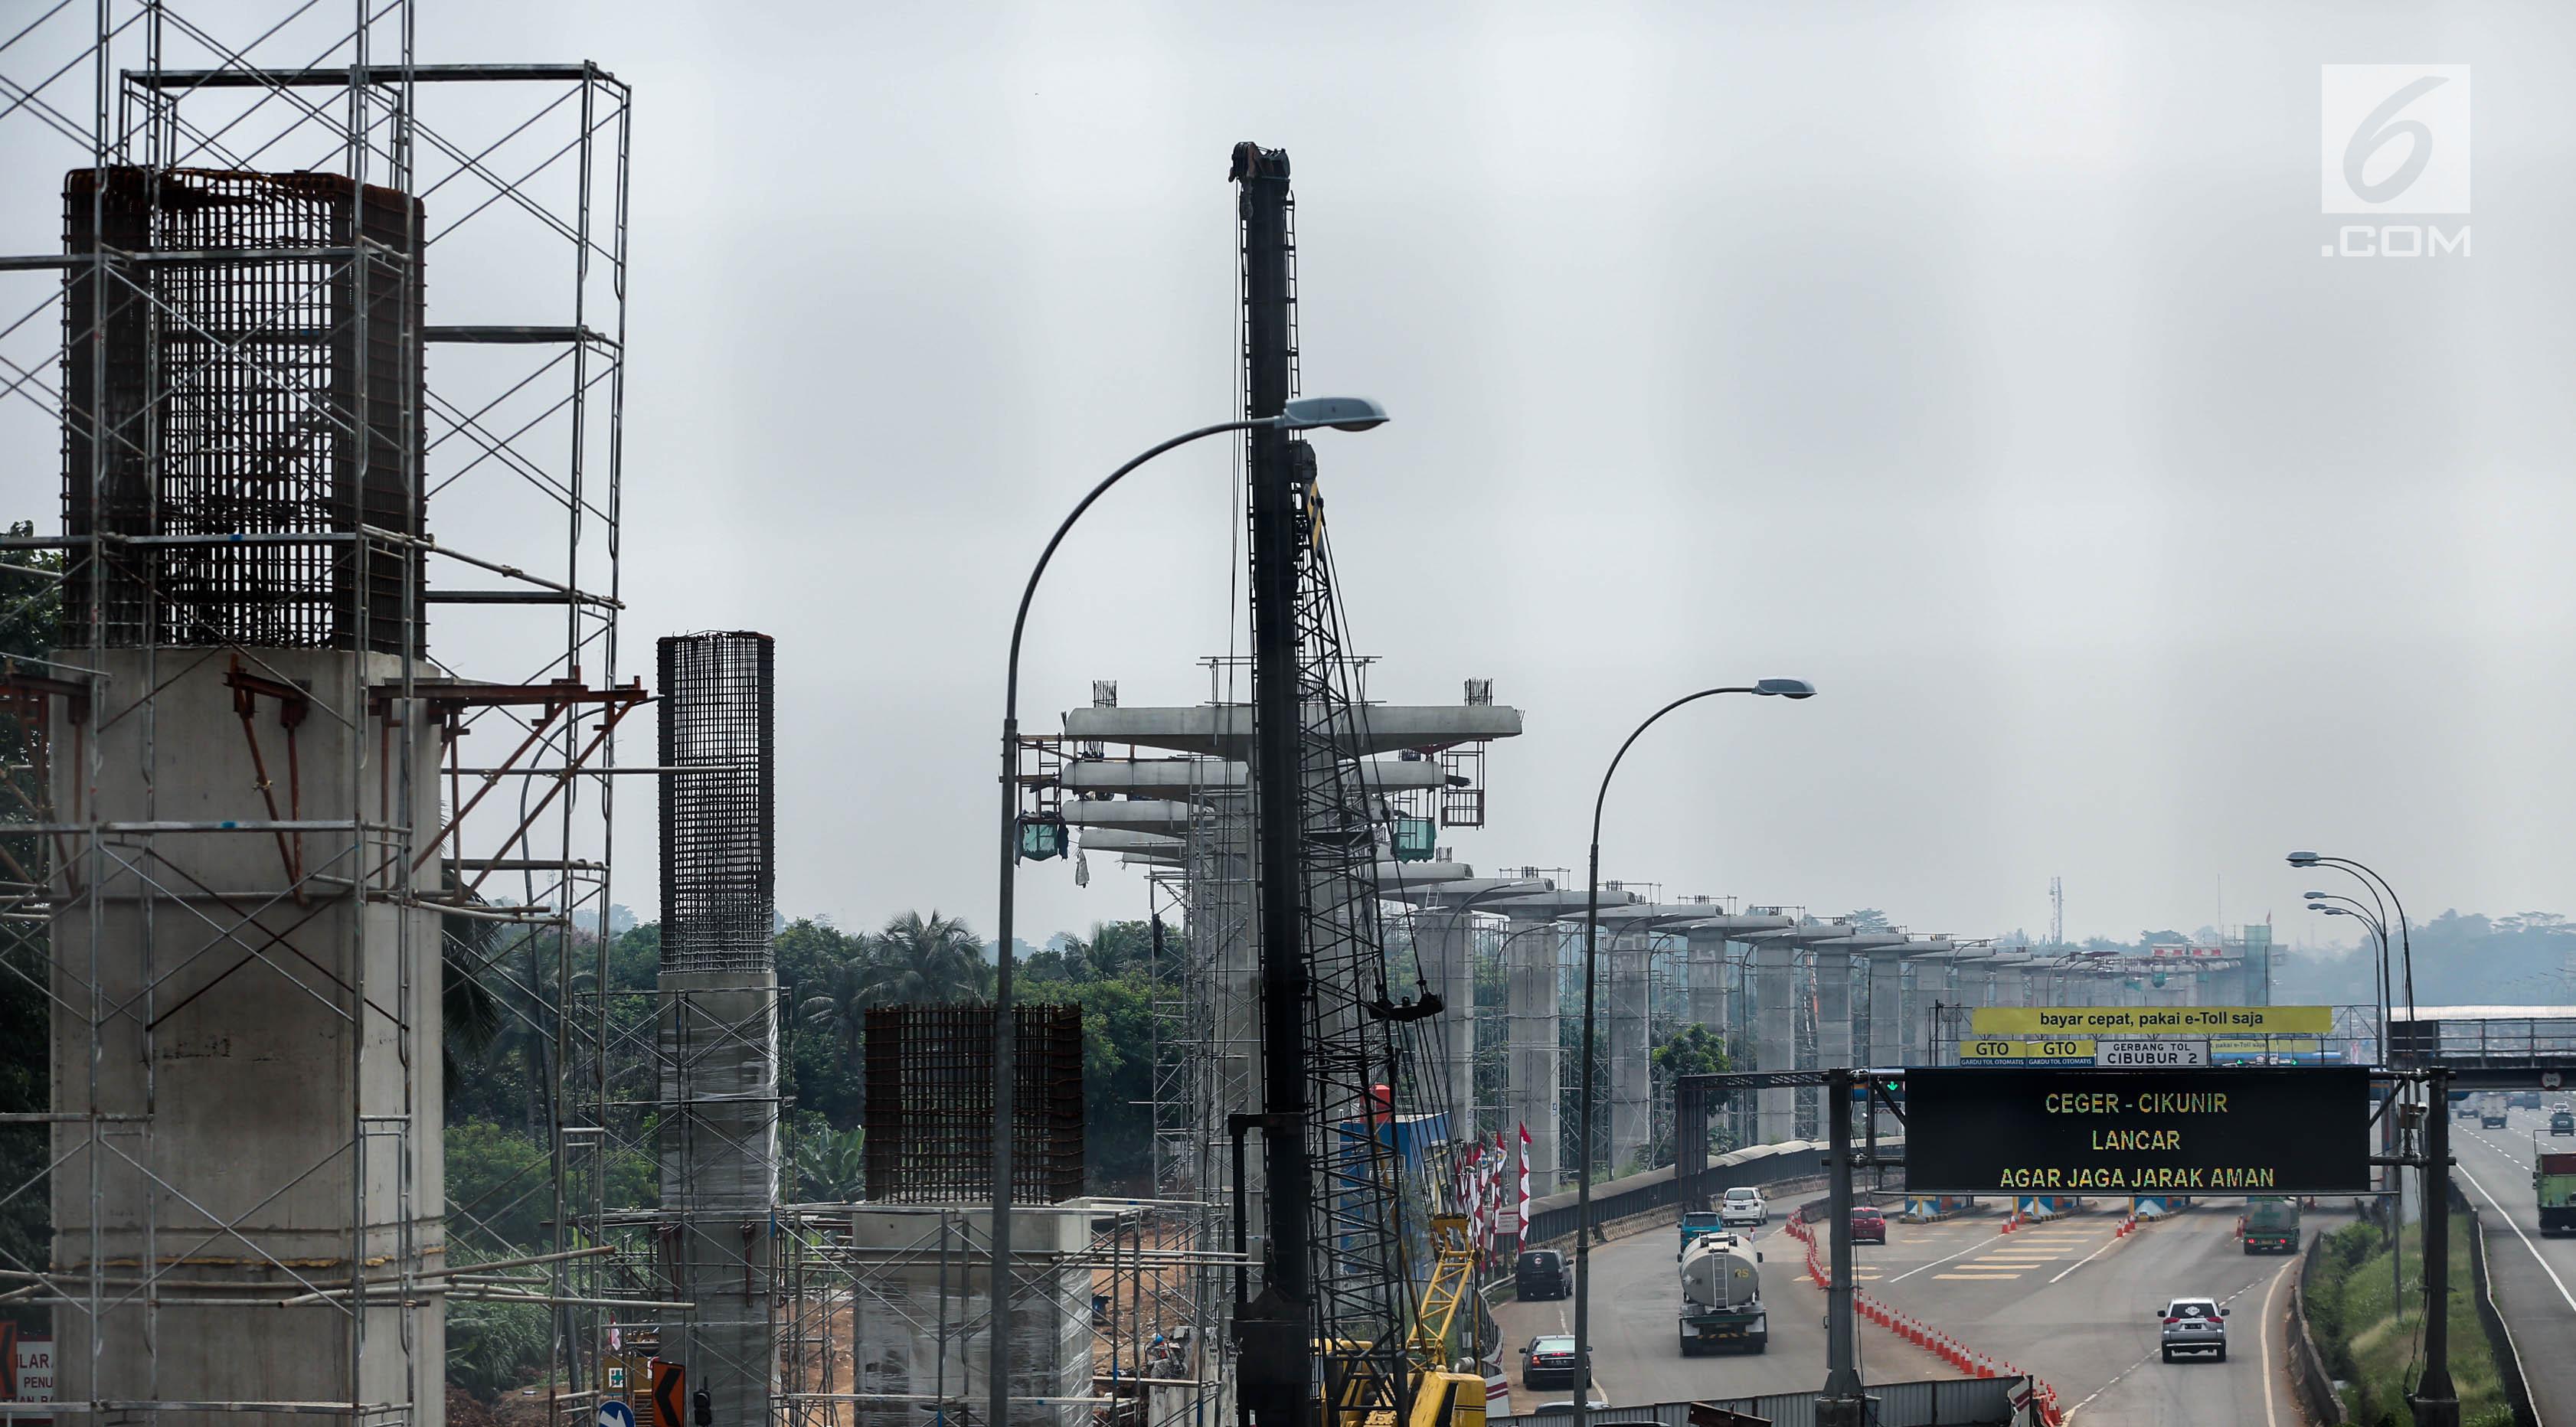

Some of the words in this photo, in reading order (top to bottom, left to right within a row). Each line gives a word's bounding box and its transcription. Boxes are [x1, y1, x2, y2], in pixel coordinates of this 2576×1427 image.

[2040, 1012, 2084, 1027] bayar
[2087, 1013, 2134, 1027] cepat,
[2139, 1012, 2180, 1027] pakai
[2185, 1011, 2227, 1025] e-Toll
[2231, 1011, 2264, 1027] saja
[1976, 1042, 2009, 1055] GTO
[2043, 1041, 2077, 1055] GTO
[2113, 1043, 2164, 1052] GERBANG
[2170, 1043, 2191, 1051] TOL
[2107, 1053, 2178, 1064] CIBUBUR
[2188, 1053, 2198, 1064] 2
[2045, 1093, 2120, 1112] CEGER
[2139, 1093, 2228, 1112] CIKUNIR
[2093, 1130, 2181, 1150] LANCAR
[2000, 1168, 2061, 1187] AGAR
[2068, 1168, 2126, 1187] JAGA
[2131, 1168, 2204, 1187] JARAK
[2211, 1168, 2274, 1187] AMAN
